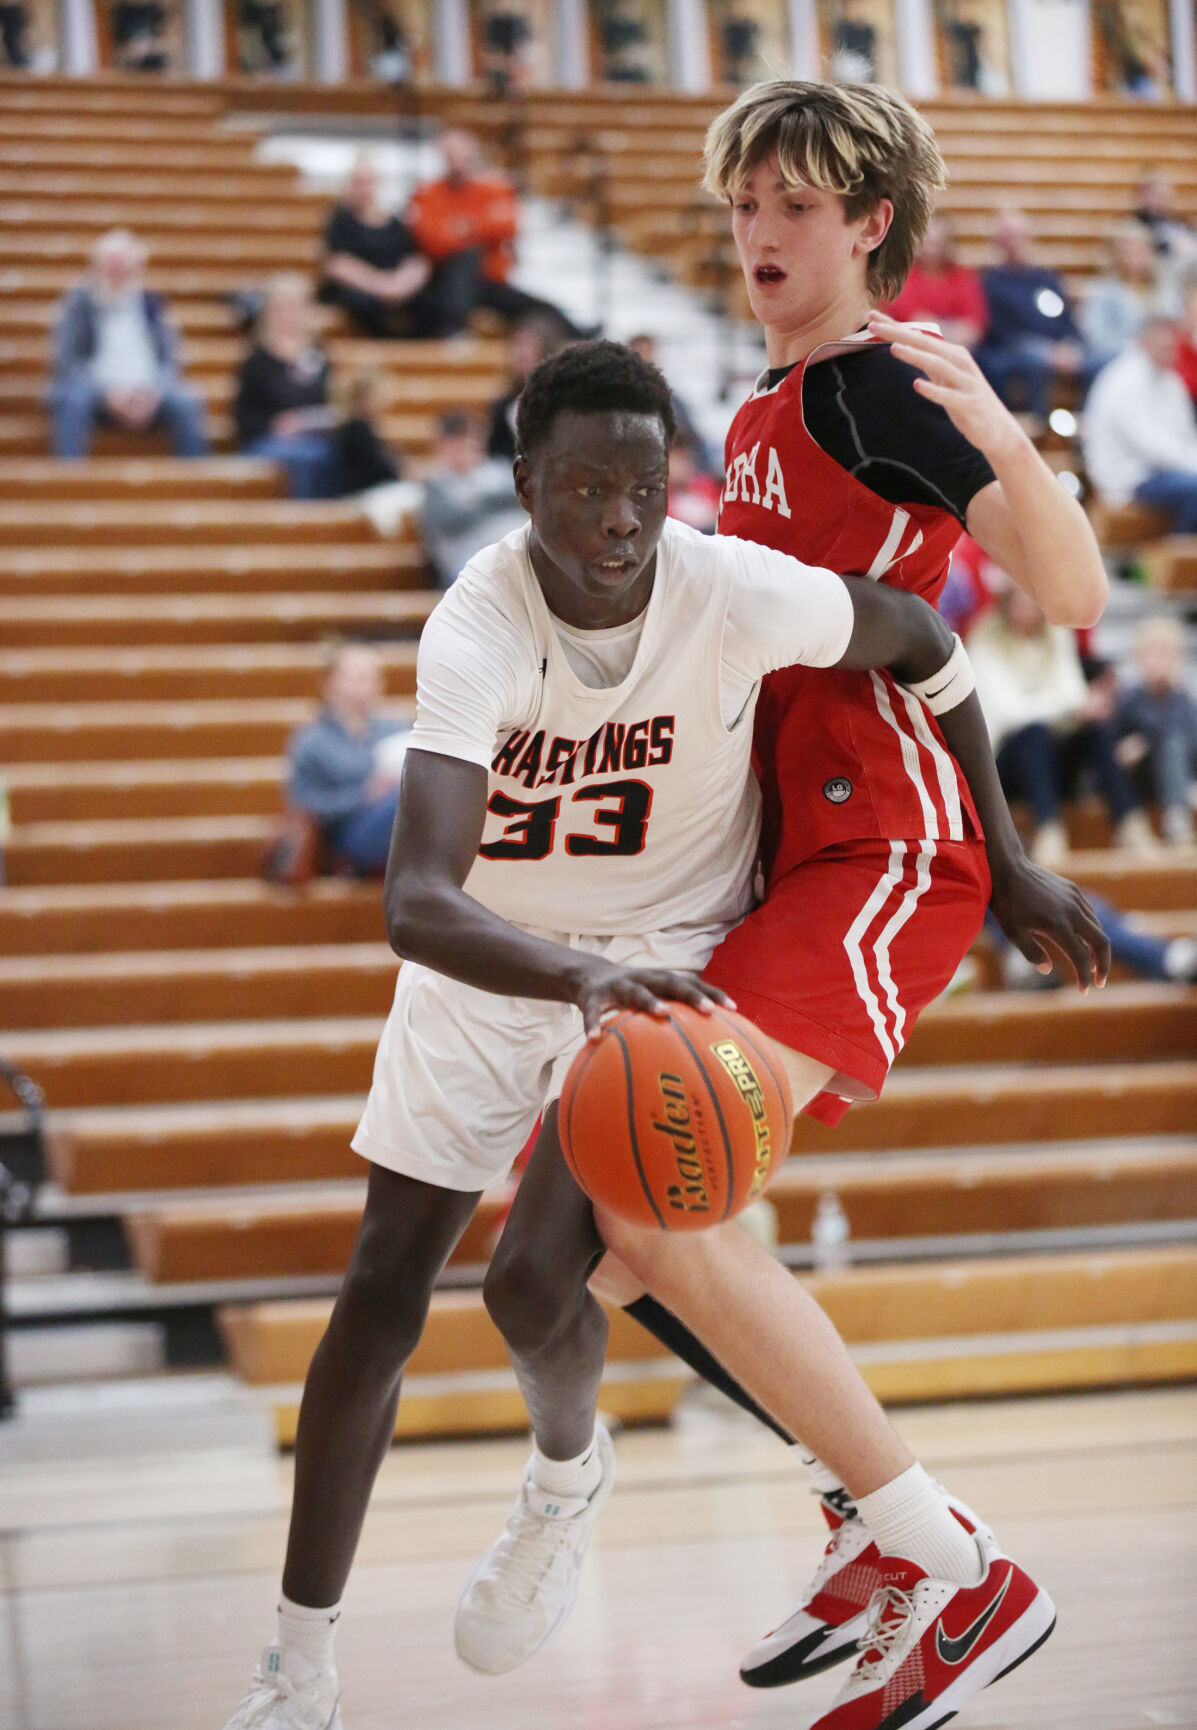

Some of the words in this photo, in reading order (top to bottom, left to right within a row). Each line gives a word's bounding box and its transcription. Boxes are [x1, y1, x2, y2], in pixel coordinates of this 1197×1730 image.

[491, 715, 675, 789] HASTINGS
[477, 779, 654, 861] 33
[714, 1042, 757, 1093] PRO
[653, 1071, 710, 1212] Baden
